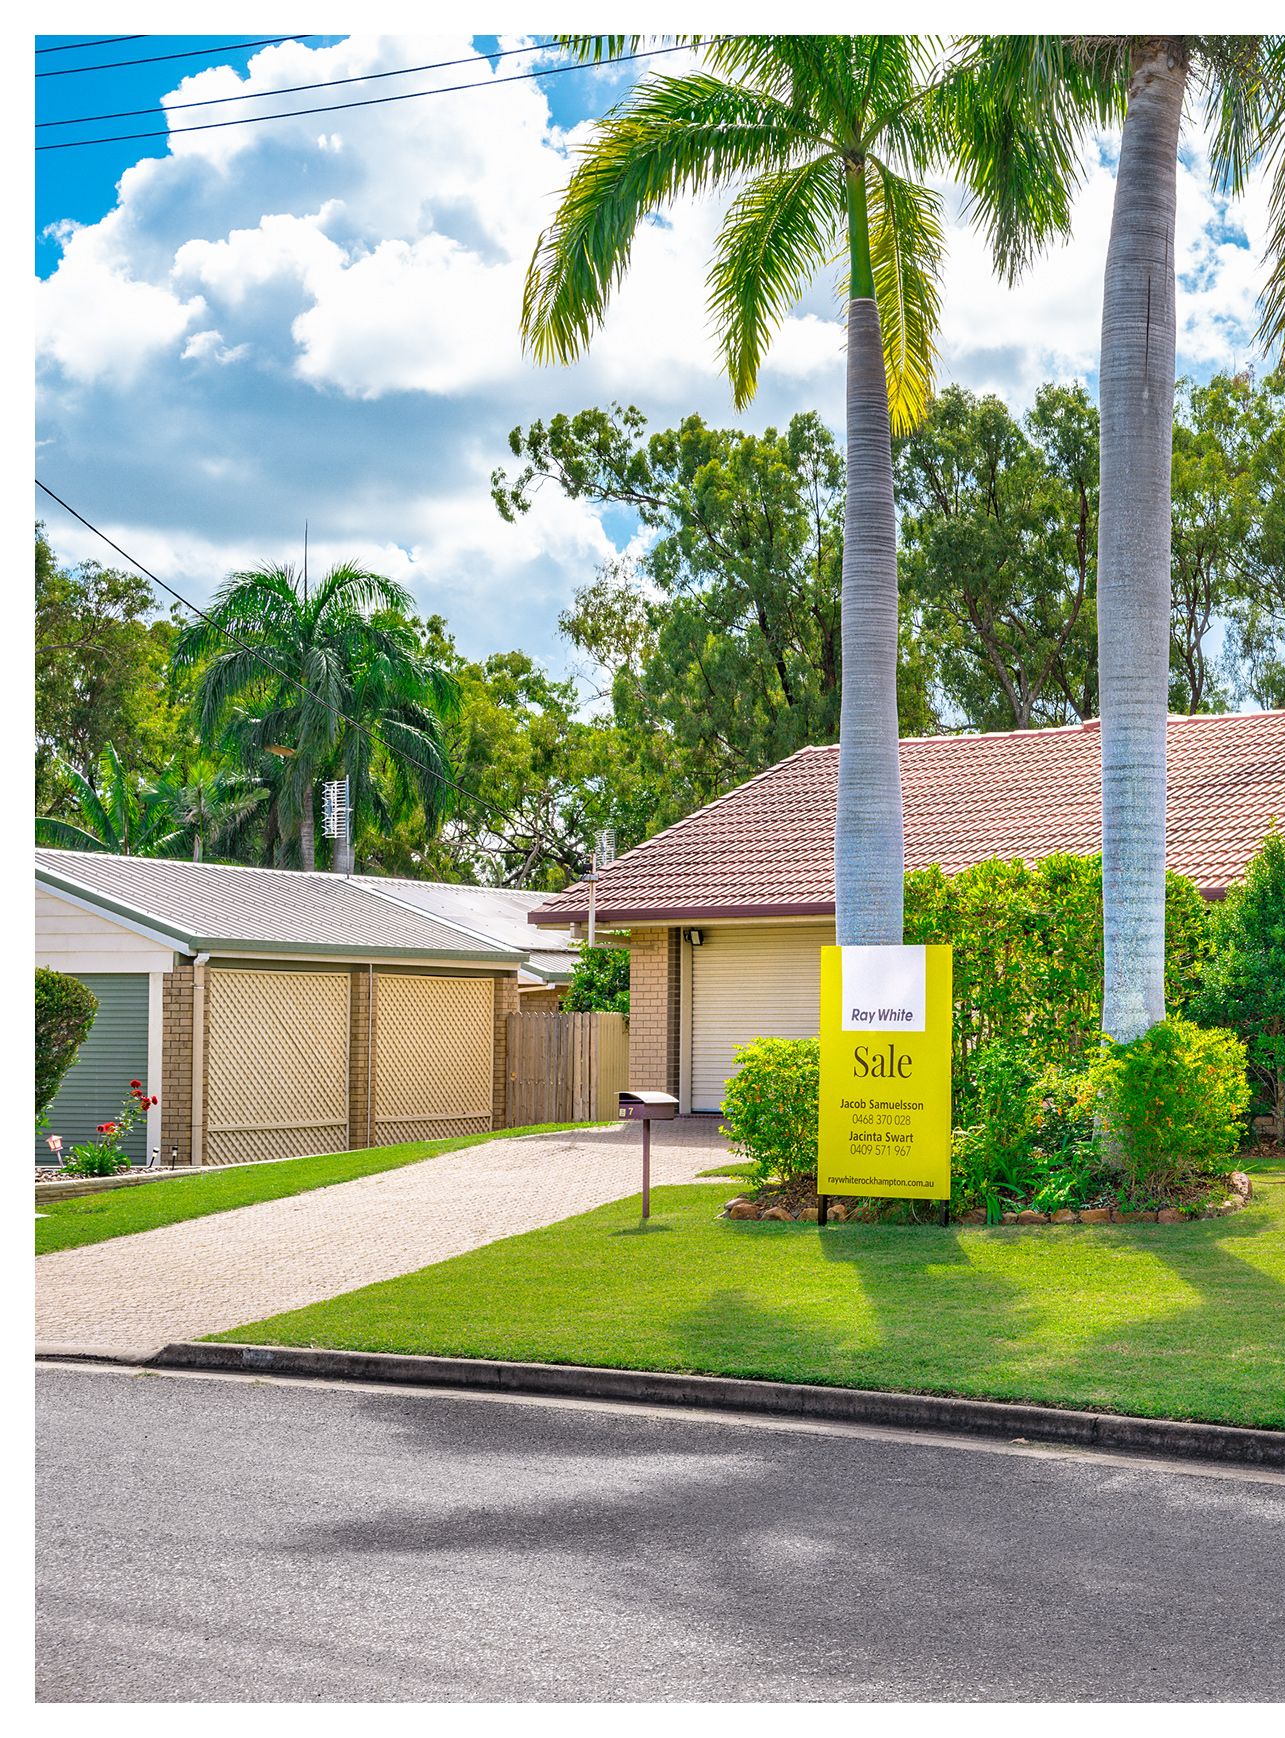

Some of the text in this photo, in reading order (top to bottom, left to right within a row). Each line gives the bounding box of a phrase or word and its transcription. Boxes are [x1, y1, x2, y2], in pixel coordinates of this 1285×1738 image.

[851, 1008, 914, 1024] Ray White
[853, 1043, 913, 1079] Sale
[840, 1098, 925, 1111] Jacob Samuelsson
[628, 1107, 634, 1116] 7
[852, 1113, 912, 1126] 0468 370 028
[848, 1131, 914, 1143] Jacinta Swart
[850, 1144, 912, 1157] 0409 571 967
[827, 1175, 935, 1188] raywhiterockhampton.com.au
